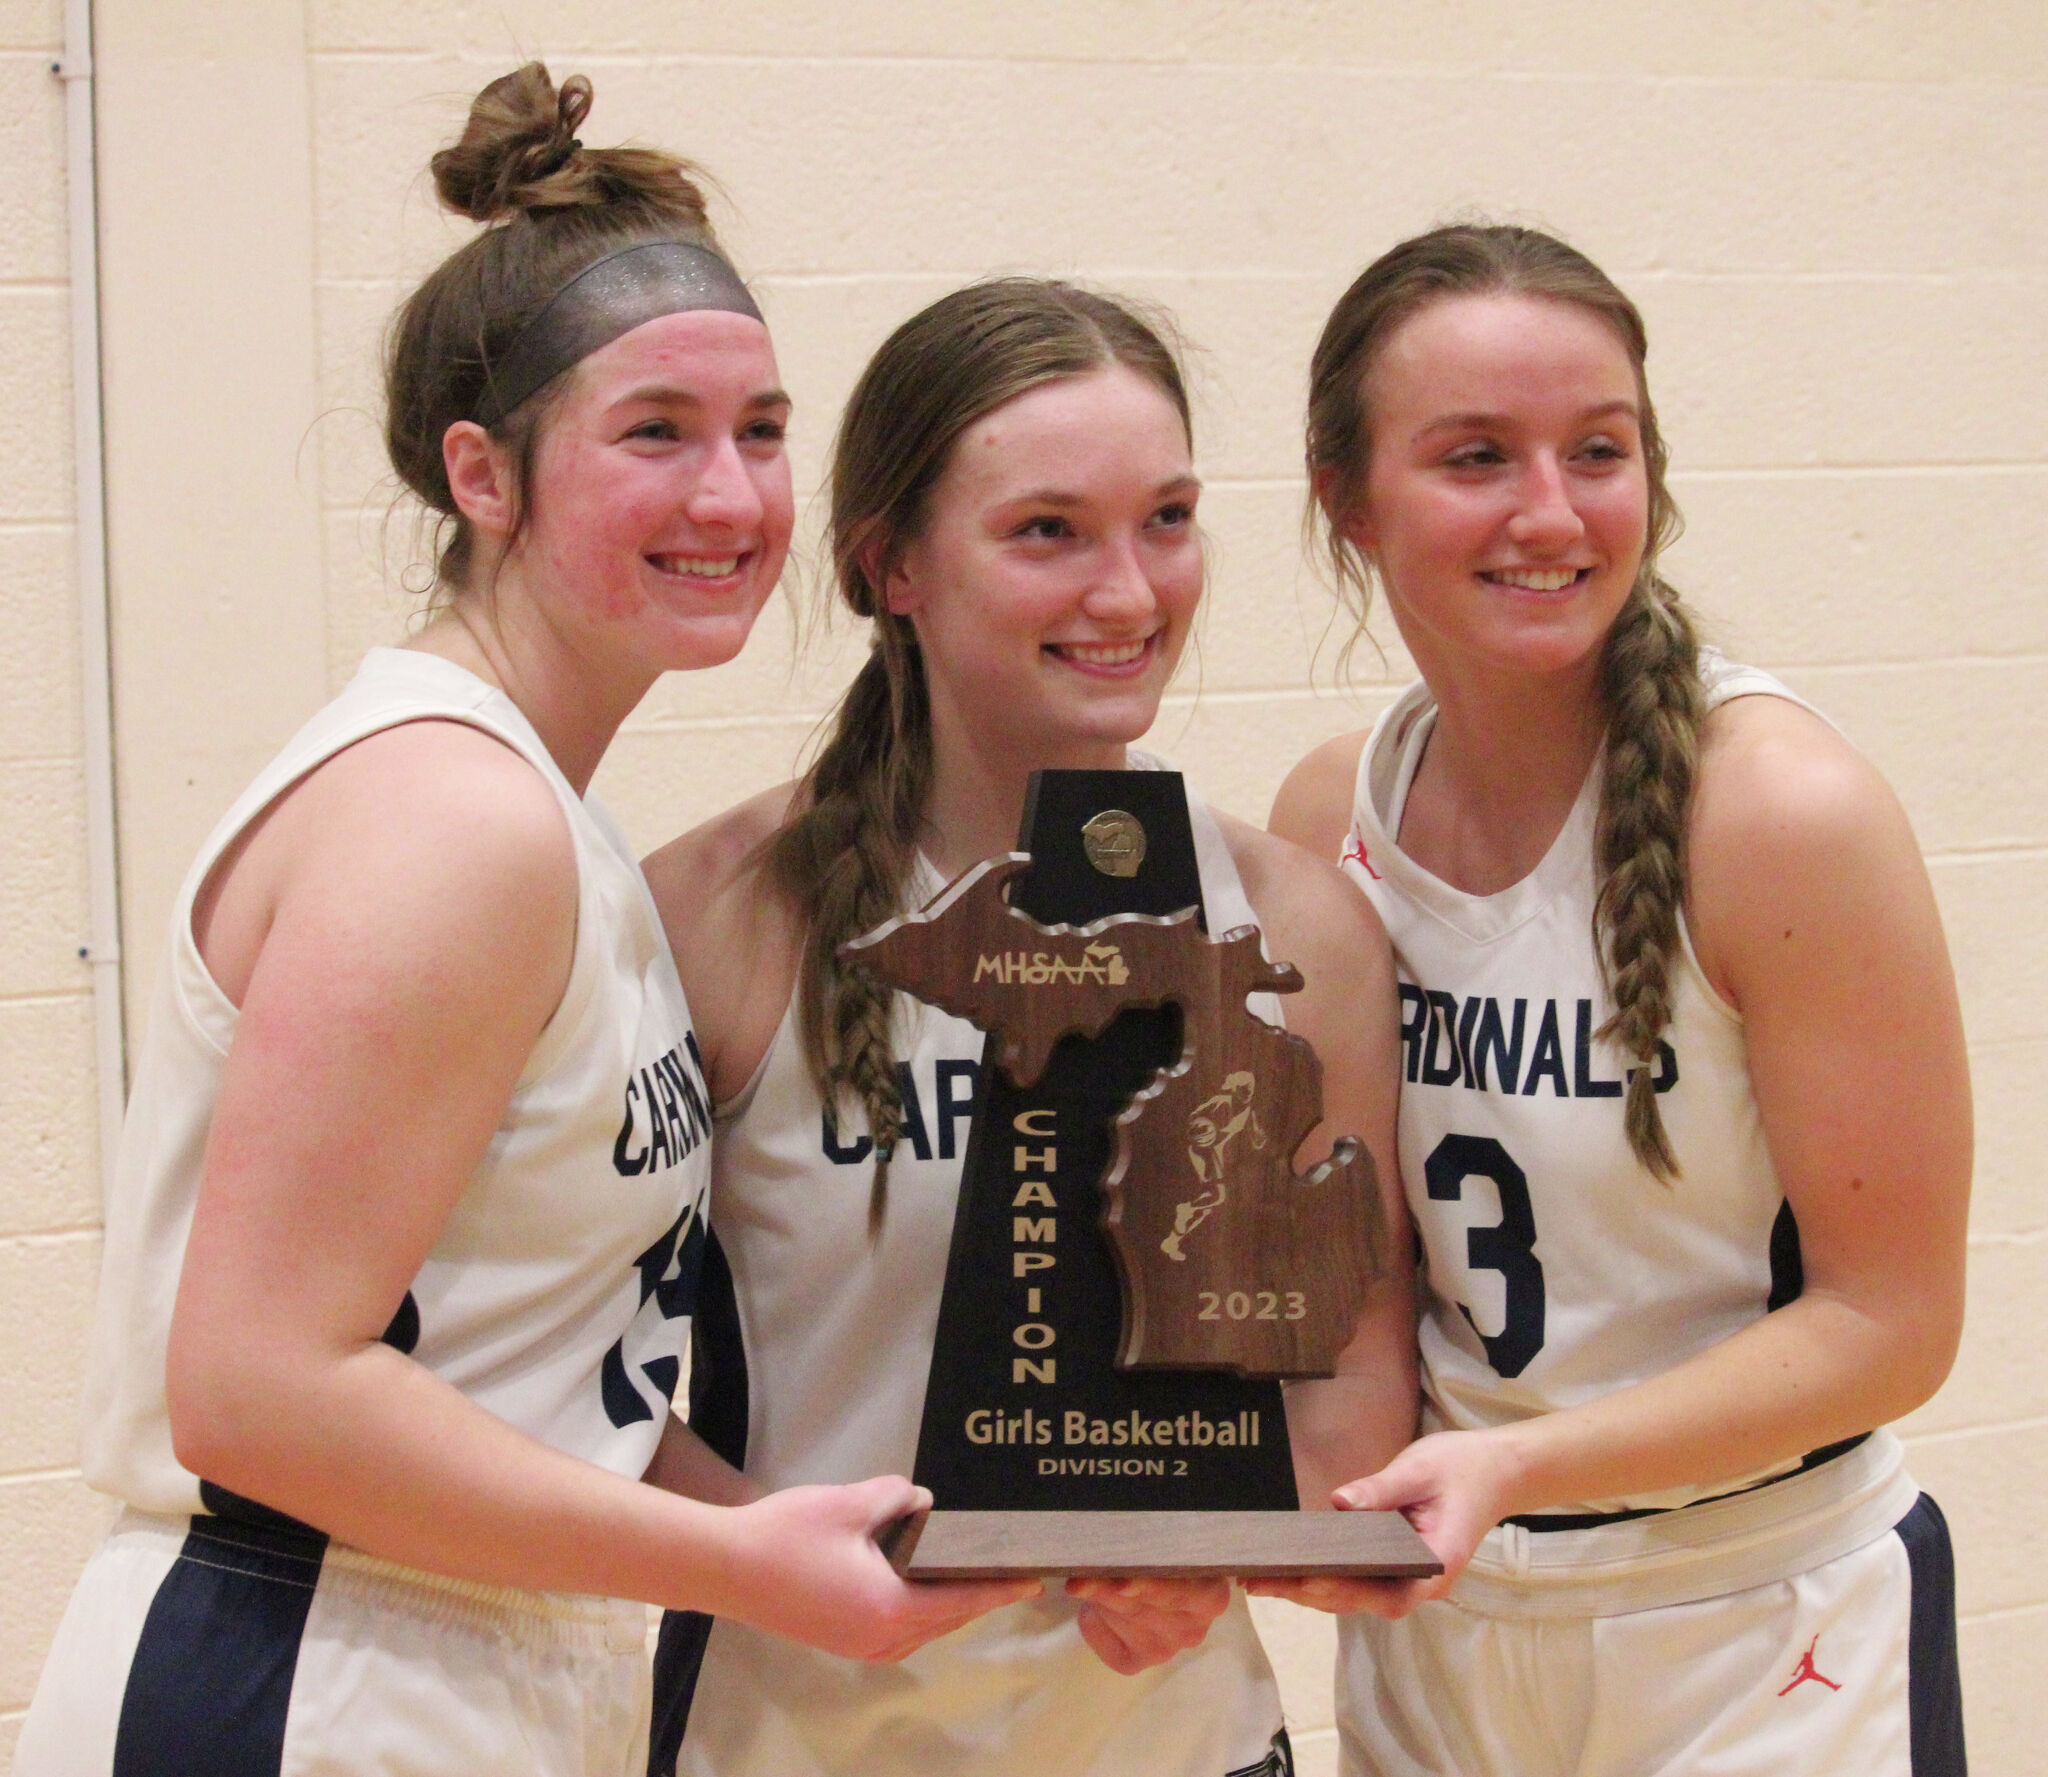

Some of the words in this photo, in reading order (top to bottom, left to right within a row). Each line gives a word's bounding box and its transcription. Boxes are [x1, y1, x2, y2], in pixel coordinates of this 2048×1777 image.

[973, 951, 1106, 985] MHSAA
[1012, 1109, 1058, 1384] CHAMPION
[1424, 1133, 1545, 1378] 3
[1198, 1291, 1307, 1321] 2023
[965, 1409, 1052, 1446] Girls
[1064, 1409, 1260, 1447] Basketball
[1038, 1458, 1165, 1476] DIVISION
[1173, 1459, 1188, 1476] 2
